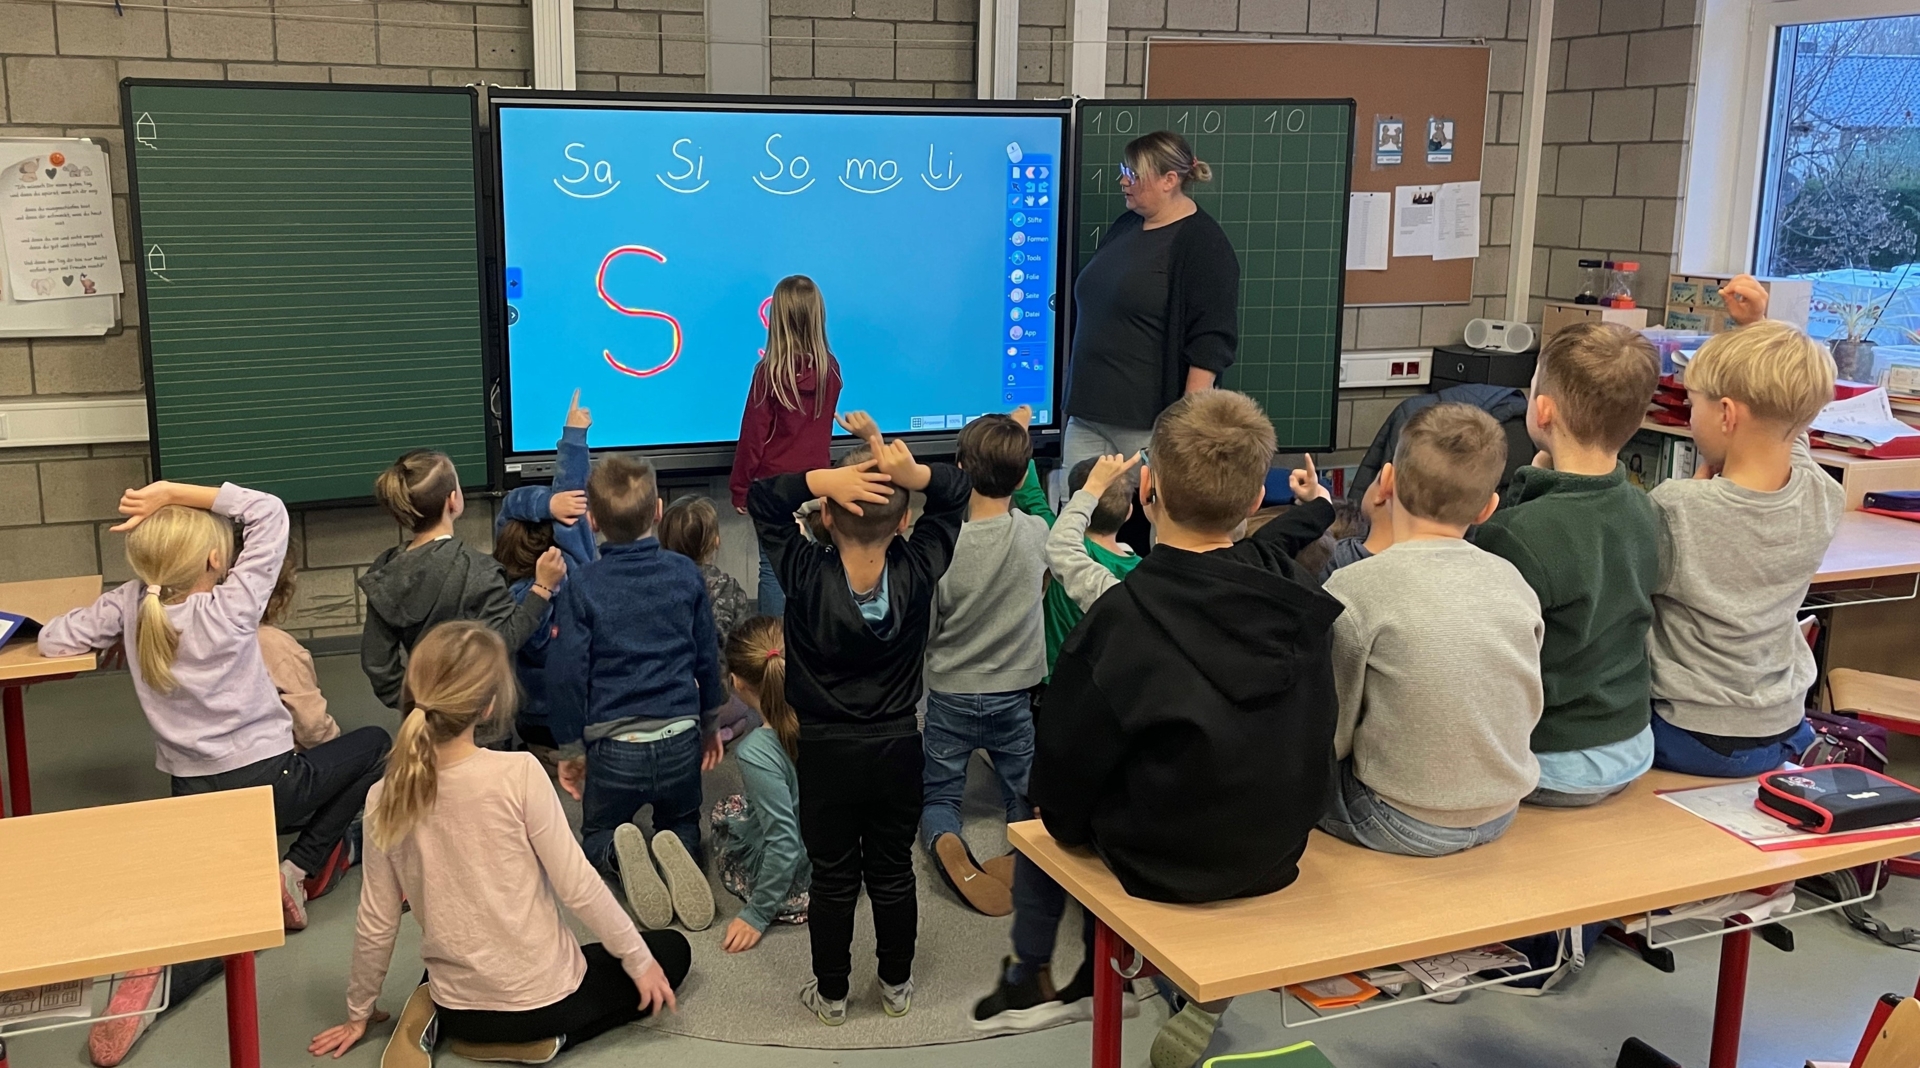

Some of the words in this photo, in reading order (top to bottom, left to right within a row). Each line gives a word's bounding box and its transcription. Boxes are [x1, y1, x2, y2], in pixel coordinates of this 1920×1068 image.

[562, 142, 613, 184] Sa
[667, 138, 704, 182] Si
[759, 132, 810, 181] So
[846, 157, 898, 182] mo
[594, 244, 683, 378] S
